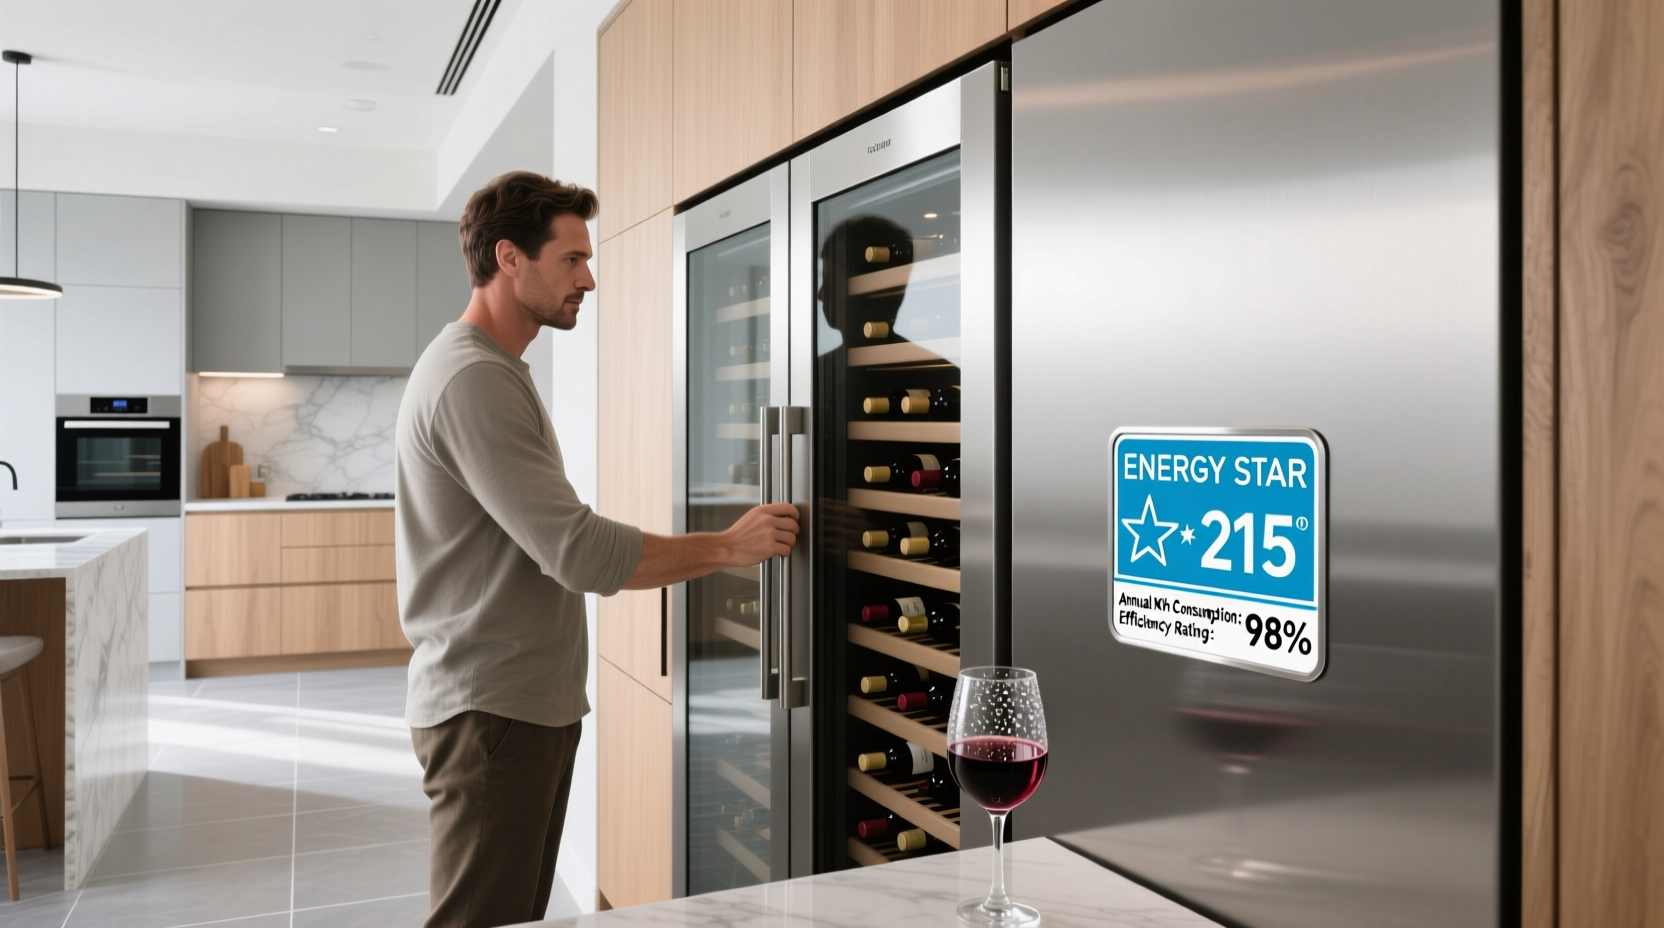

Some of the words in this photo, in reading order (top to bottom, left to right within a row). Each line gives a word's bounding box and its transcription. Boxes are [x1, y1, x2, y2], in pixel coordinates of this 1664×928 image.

[1124, 453, 1226, 484] ENERGY
[1234, 456, 1307, 488] STAR
[1119, 592, 1152, 610] Annual
[1174, 620, 1214, 644] Rating:
[1245, 613, 1312, 655] 98%
